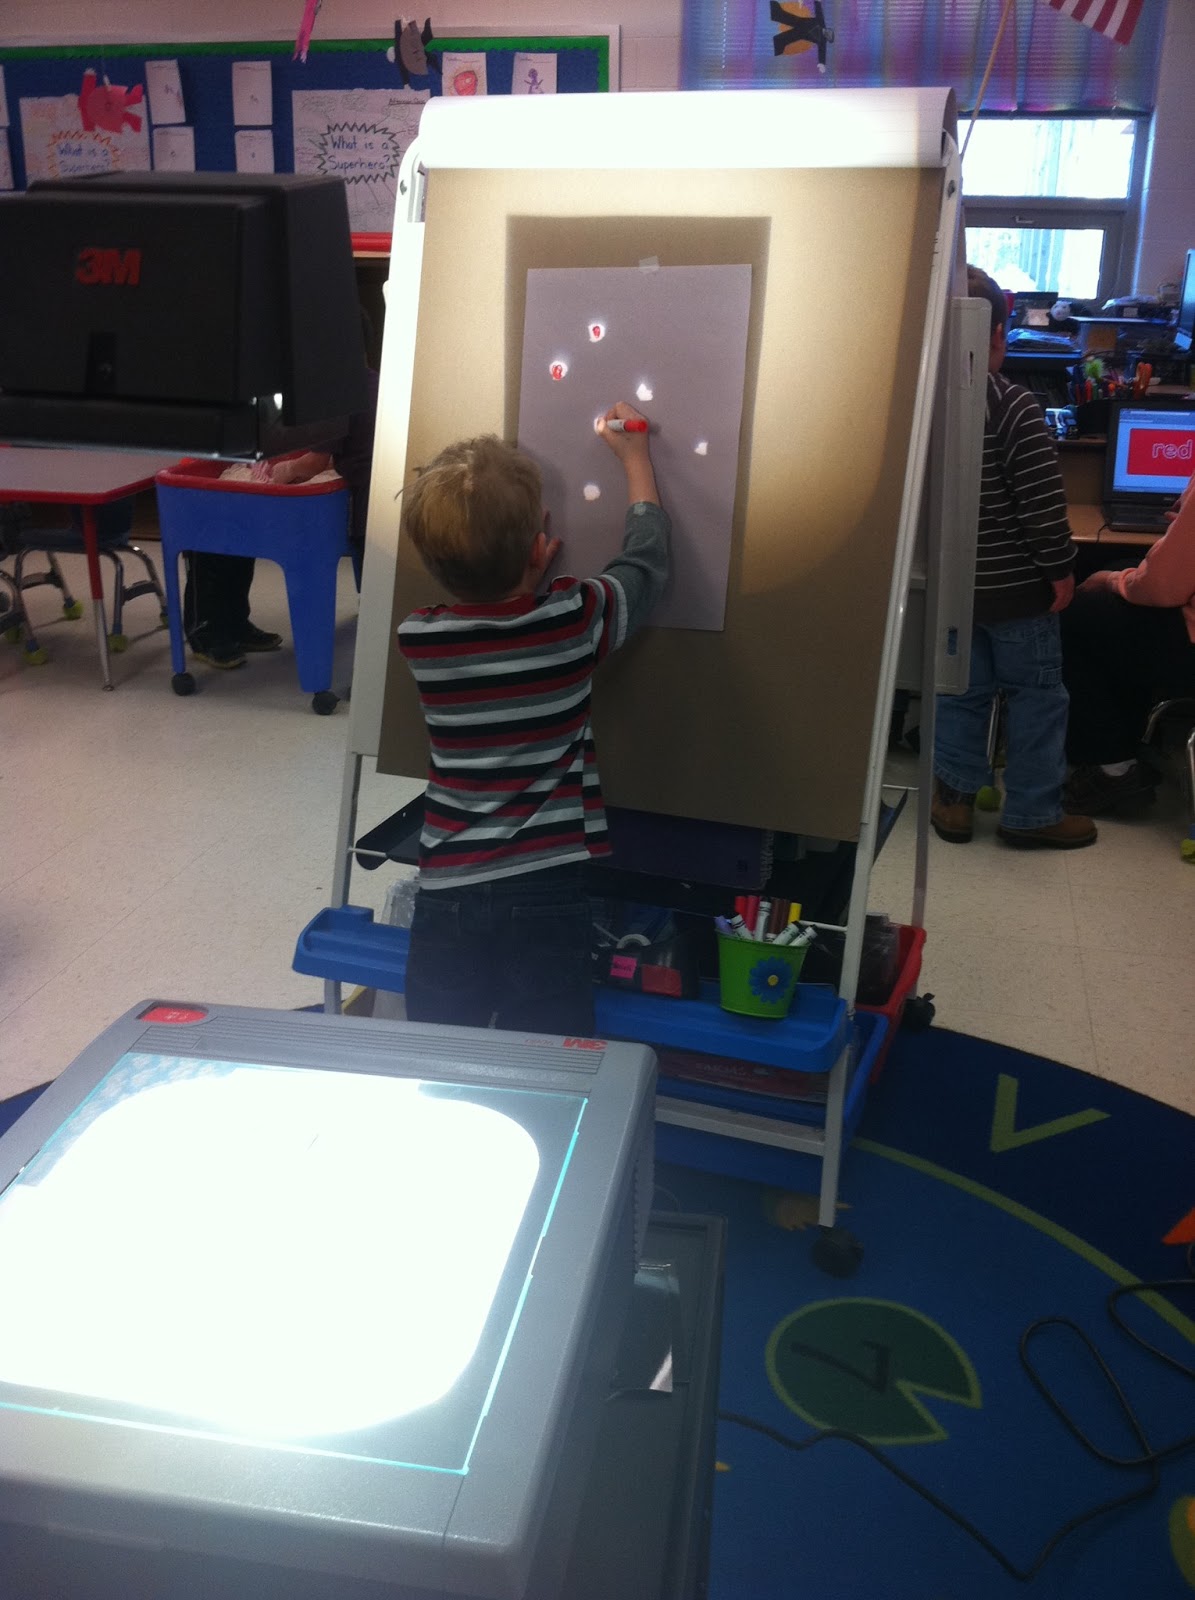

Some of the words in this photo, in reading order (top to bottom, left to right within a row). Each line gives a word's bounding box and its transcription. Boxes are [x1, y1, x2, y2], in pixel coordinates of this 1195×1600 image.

[57, 142, 83, 156] What
[331, 136, 357, 150] What
[364, 137, 374, 150] is
[381, 142, 389, 150] a
[76, 247, 141, 285] 3M
[1152, 439, 1193, 460] red
[562, 1037, 609, 1051] 3M
